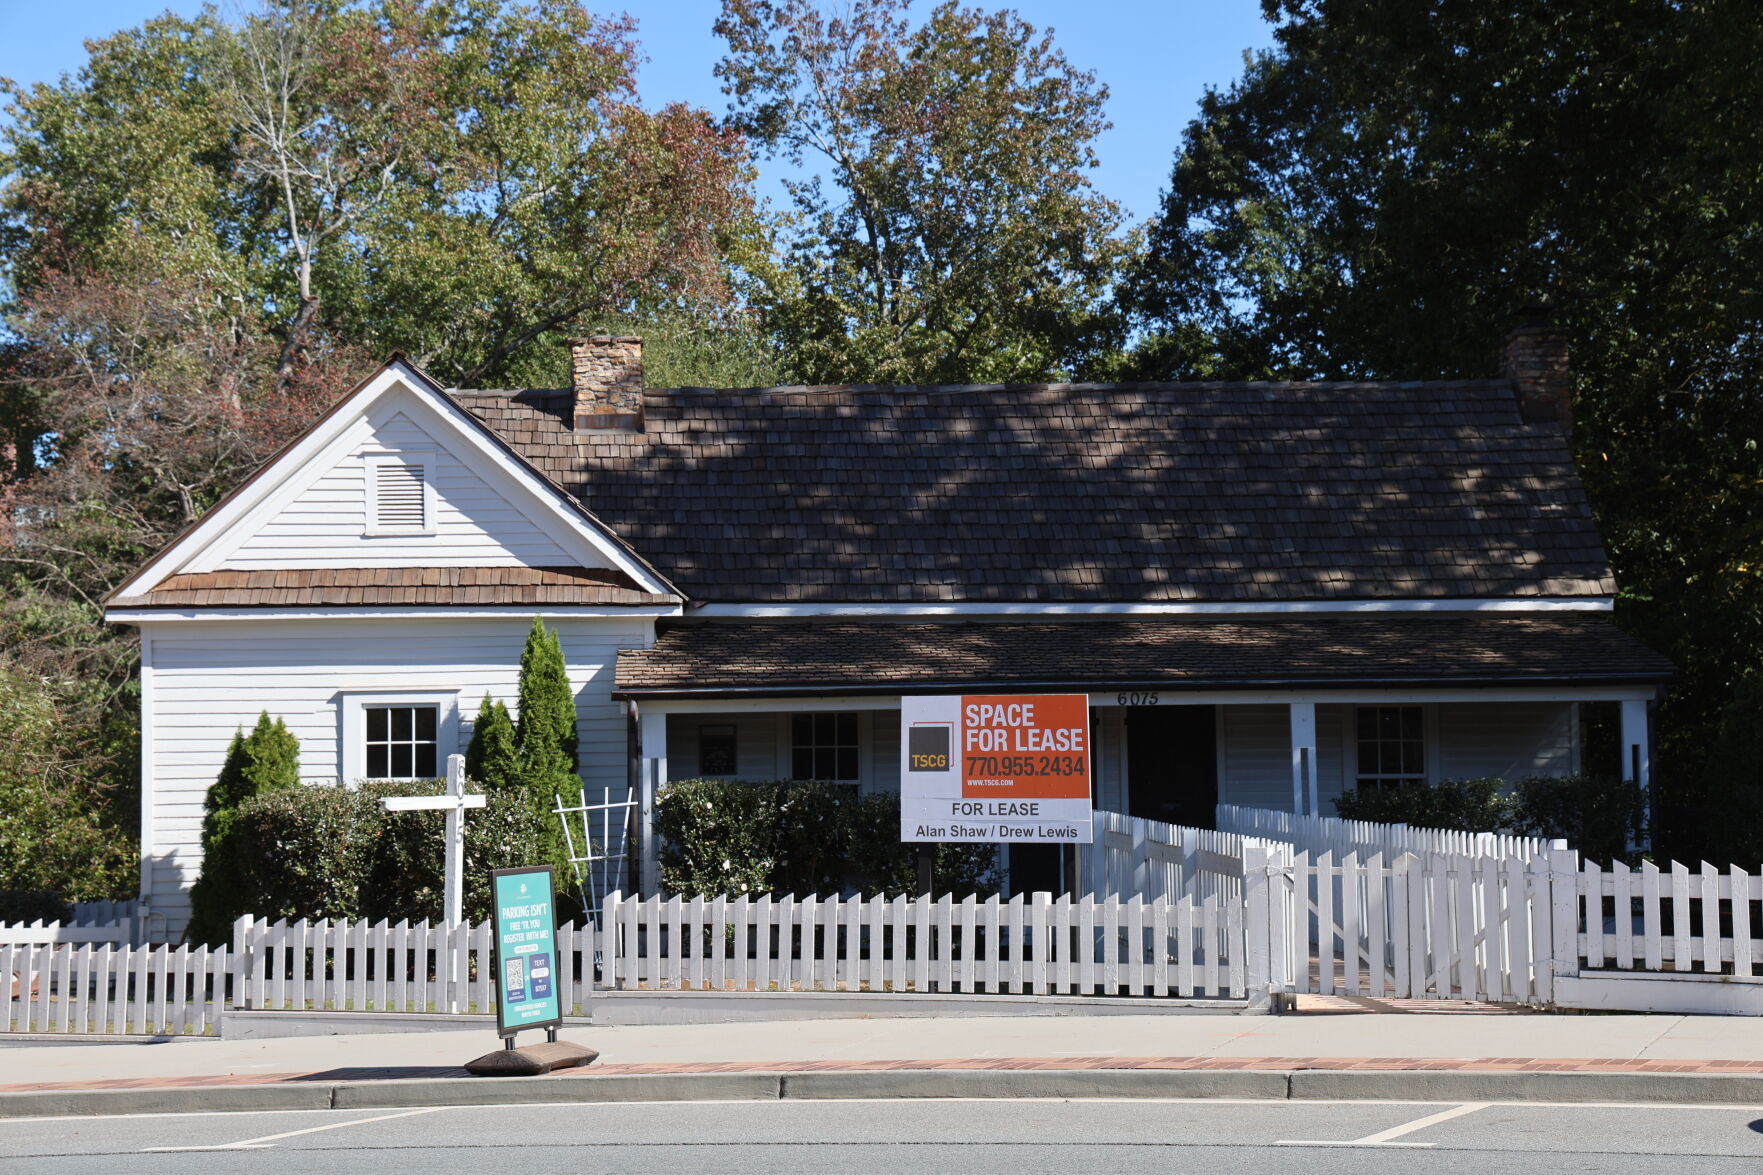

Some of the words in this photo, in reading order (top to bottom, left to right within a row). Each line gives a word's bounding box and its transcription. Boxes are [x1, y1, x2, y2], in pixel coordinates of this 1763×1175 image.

[1117, 692, 1158, 705] 6075
[965, 703, 1035, 727] SPACE
[966, 729, 1008, 752] FOR
[1015, 728, 1084, 751] LEASE
[912, 754, 946, 768] TSCG
[966, 756, 1085, 776] 770.955.2434
[456, 760, 465, 843] 6075
[952, 803, 984, 816] FOR
[988, 803, 1040, 816] LEASE
[915, 825, 946, 837] Alan
[950, 825, 987, 837] Shaw
[990, 826, 995, 837] /
[999, 825, 1034, 838] Drew
[1038, 826, 1078, 838] Lewis
[502, 905, 530, 920] PARKING
[509, 921, 521, 931] FREE
[530, 919, 541, 929] YOU
[503, 934, 525, 944] REGISTER
[526, 931, 539, 941] WITH
[534, 959, 545, 967] TEXT
